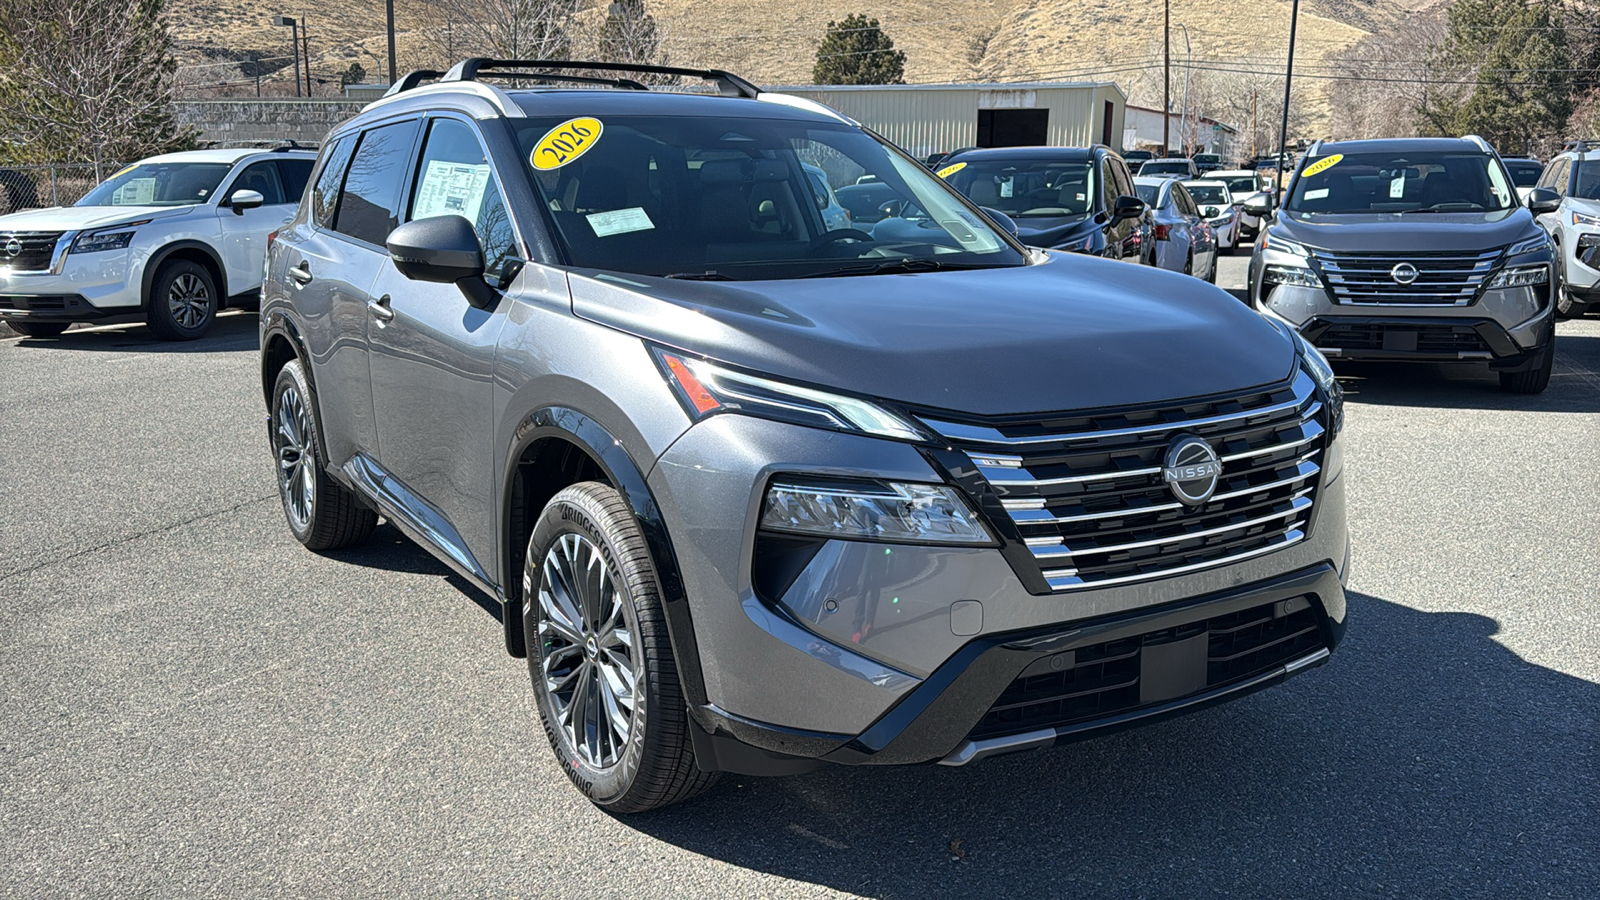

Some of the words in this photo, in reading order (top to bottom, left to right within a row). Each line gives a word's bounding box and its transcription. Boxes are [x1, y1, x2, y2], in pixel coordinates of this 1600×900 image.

[542, 123, 592, 164] 2026
[1309, 158, 1336, 173] 2026
[1166, 464, 1222, 480] NISSAN
[560, 503, 622, 581] BRIDGESTONE
[540, 710, 593, 799] BRIDGESTONE
[628, 690, 645, 770] ALENZA
